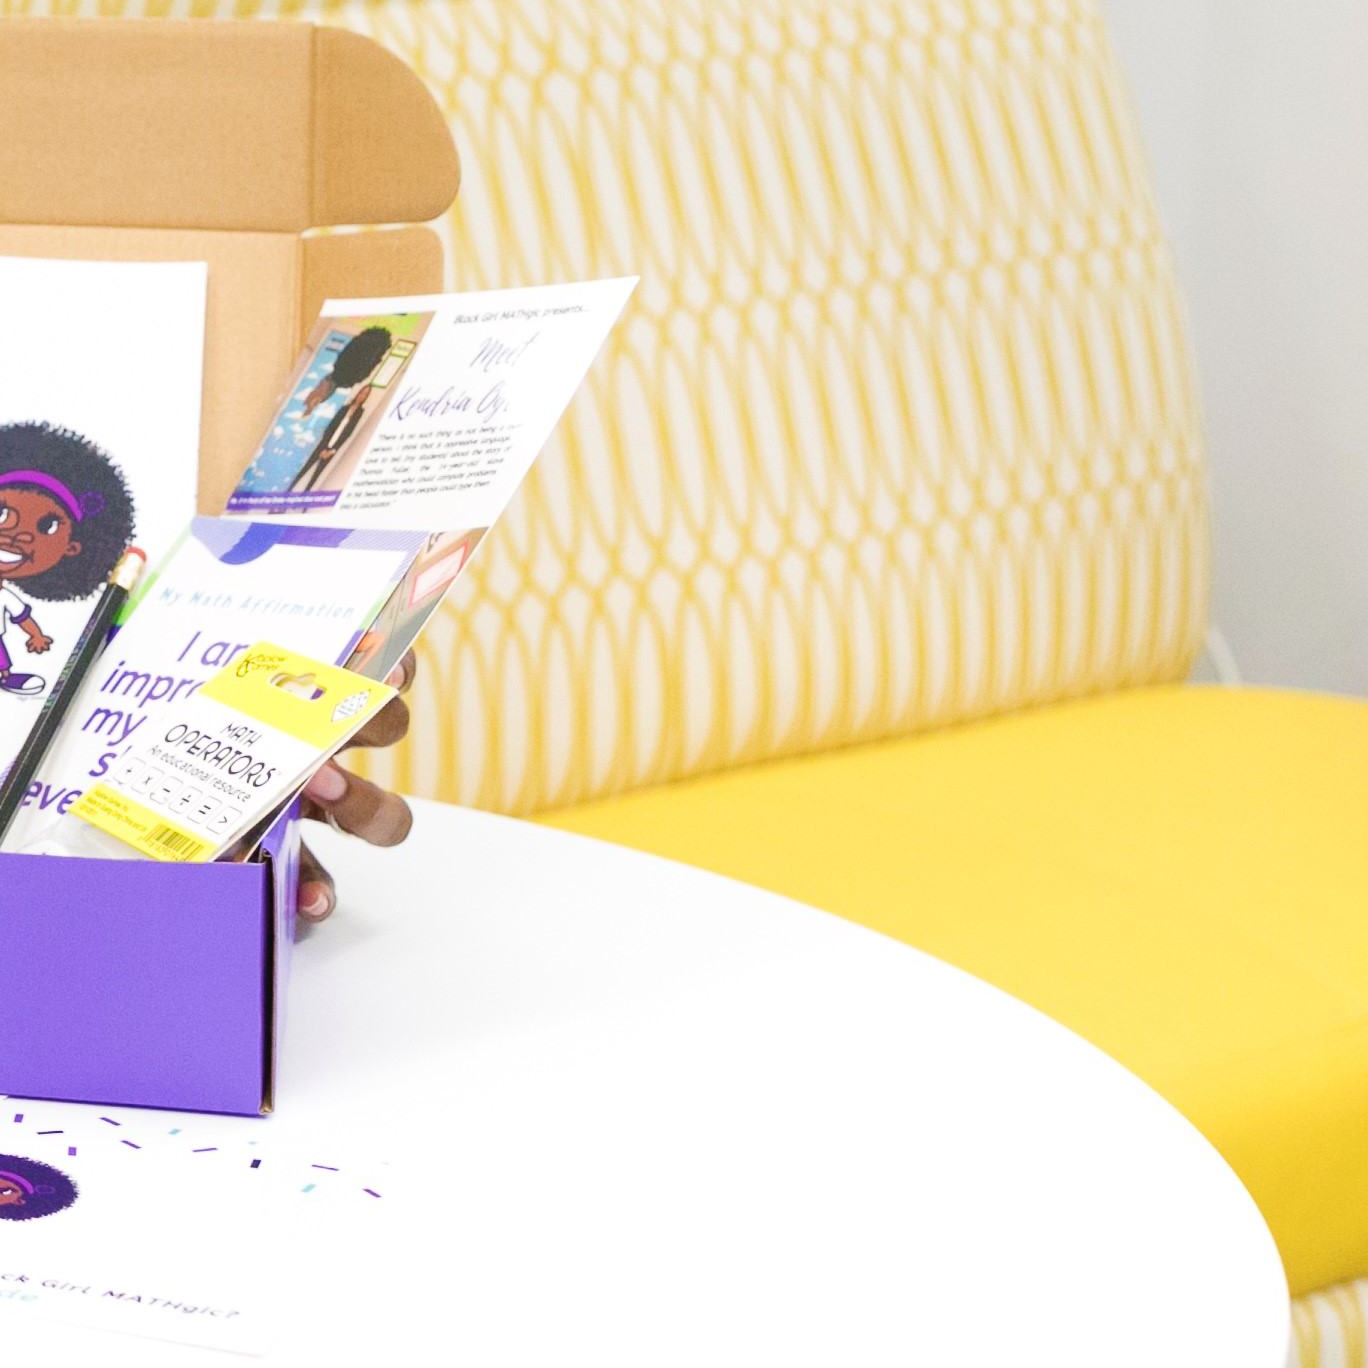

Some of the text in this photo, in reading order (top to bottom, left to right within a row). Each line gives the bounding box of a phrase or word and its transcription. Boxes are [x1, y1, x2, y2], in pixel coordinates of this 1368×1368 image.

[470, 331, 540, 373] Meet
[176, 631, 202, 662] I
[82, 707, 148, 746] my
[220, 722, 263, 748] MATH
[164, 723, 277, 788] OPERATORS
[20, 781, 83, 816] eve
[40, 1278, 93, 1296] Girl
[101, 1288, 241, 1320] MATHgic?
